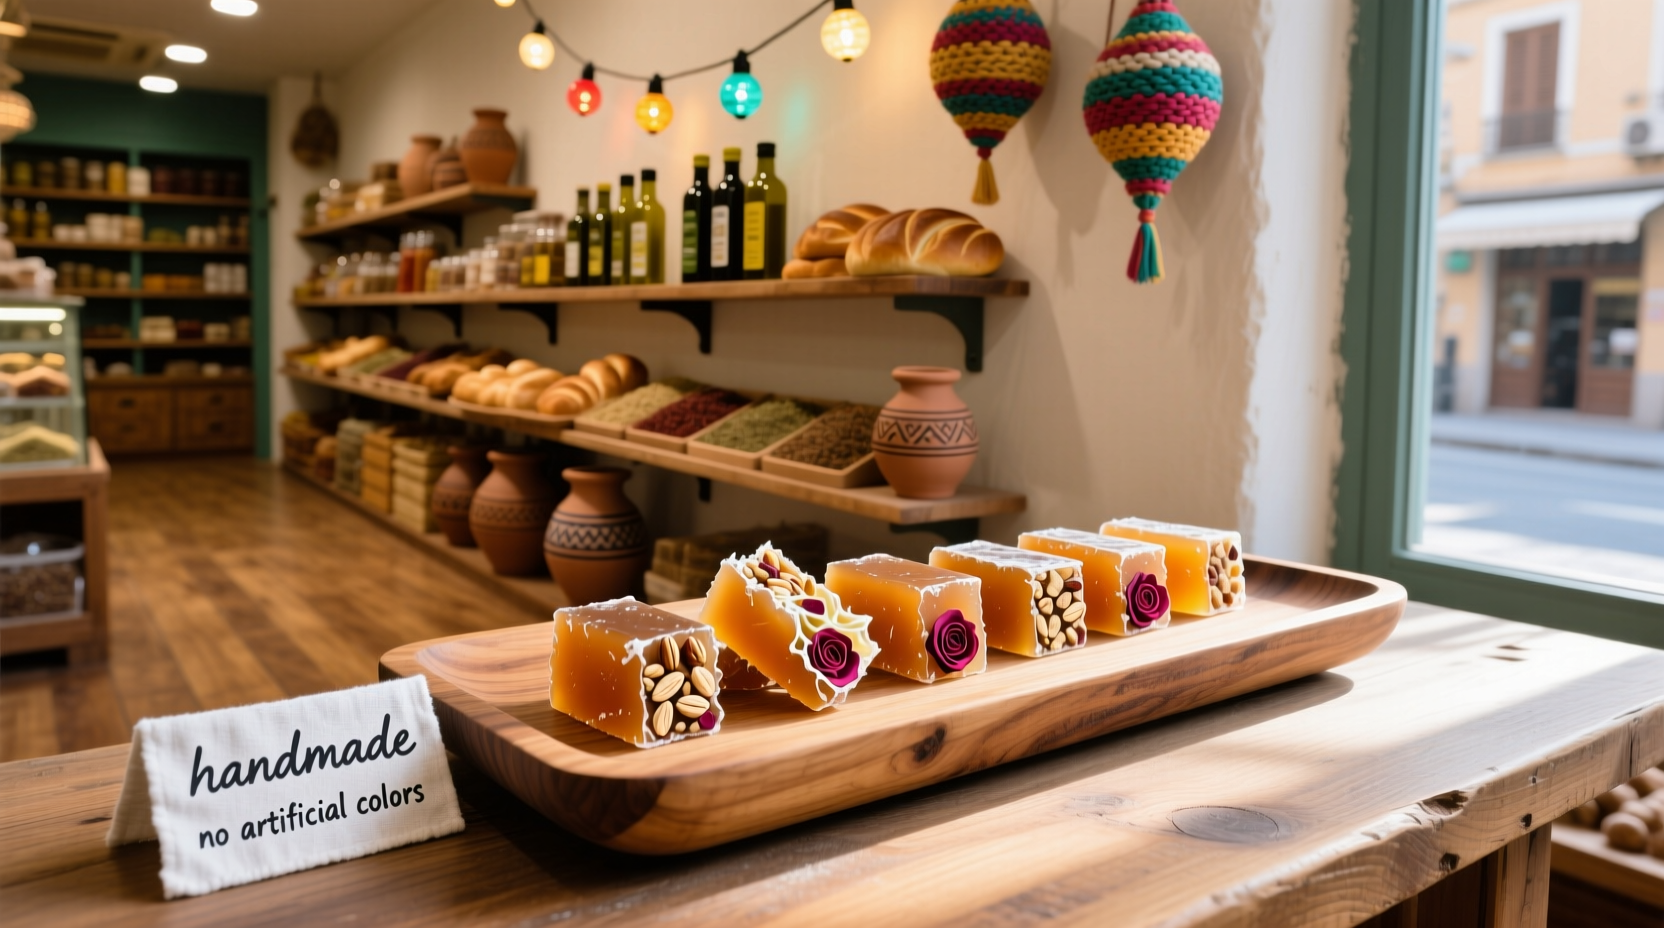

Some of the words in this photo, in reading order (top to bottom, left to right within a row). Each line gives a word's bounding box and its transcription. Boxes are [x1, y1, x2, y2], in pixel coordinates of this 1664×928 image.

[190, 713, 417, 797] handmade
[199, 827, 229, 849] no
[240, 791, 348, 841] artificial
[356, 782, 425, 815] colors
